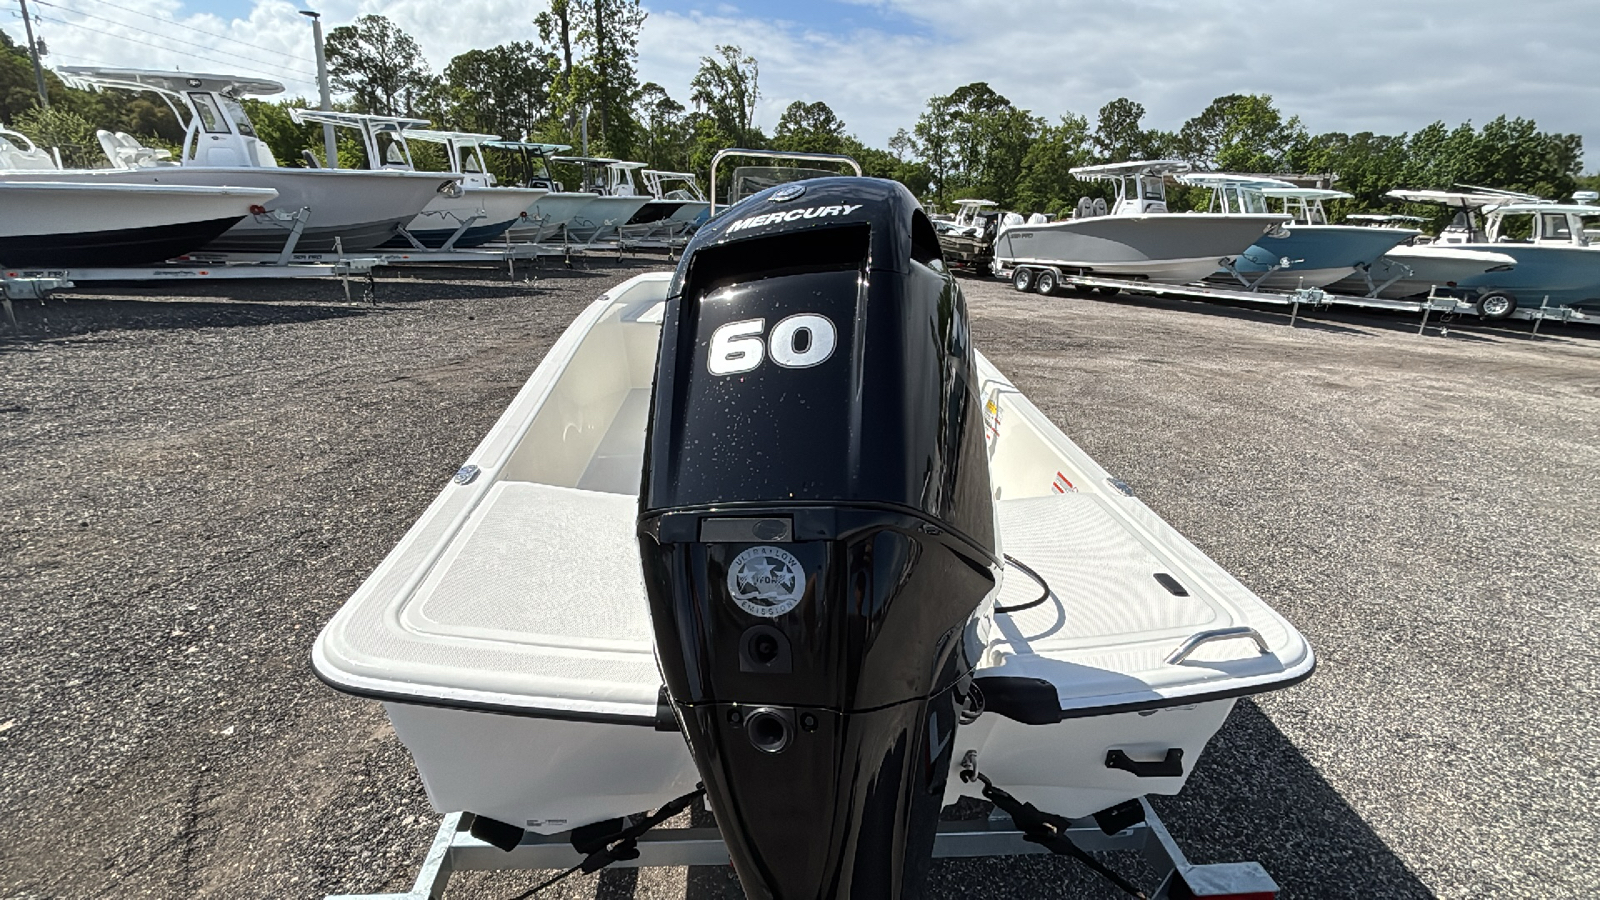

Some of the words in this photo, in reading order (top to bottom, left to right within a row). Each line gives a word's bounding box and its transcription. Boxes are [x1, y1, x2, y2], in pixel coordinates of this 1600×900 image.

[727, 204, 862, 233] MERCURY
[707, 312, 838, 376] 60
[741, 601, 793, 615] EMISSION
